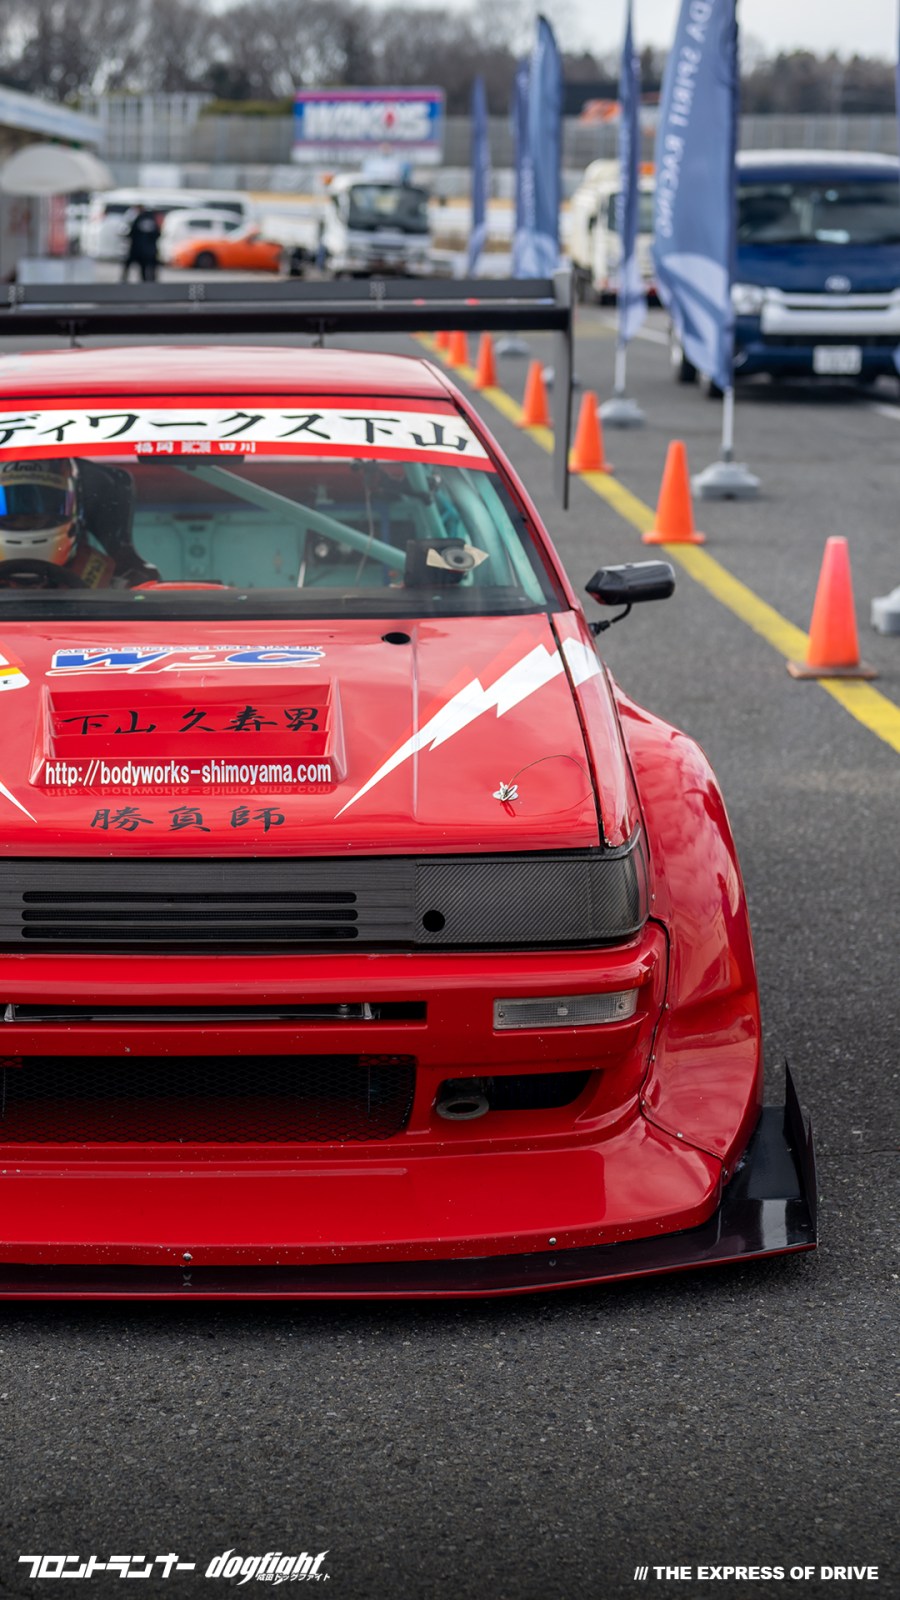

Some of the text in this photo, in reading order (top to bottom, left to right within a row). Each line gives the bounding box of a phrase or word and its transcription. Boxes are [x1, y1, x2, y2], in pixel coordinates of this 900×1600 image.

[45, 759, 332, 787] http://bodyworks-shimoyama.com
[90, 805, 286, 832] 勝負師
